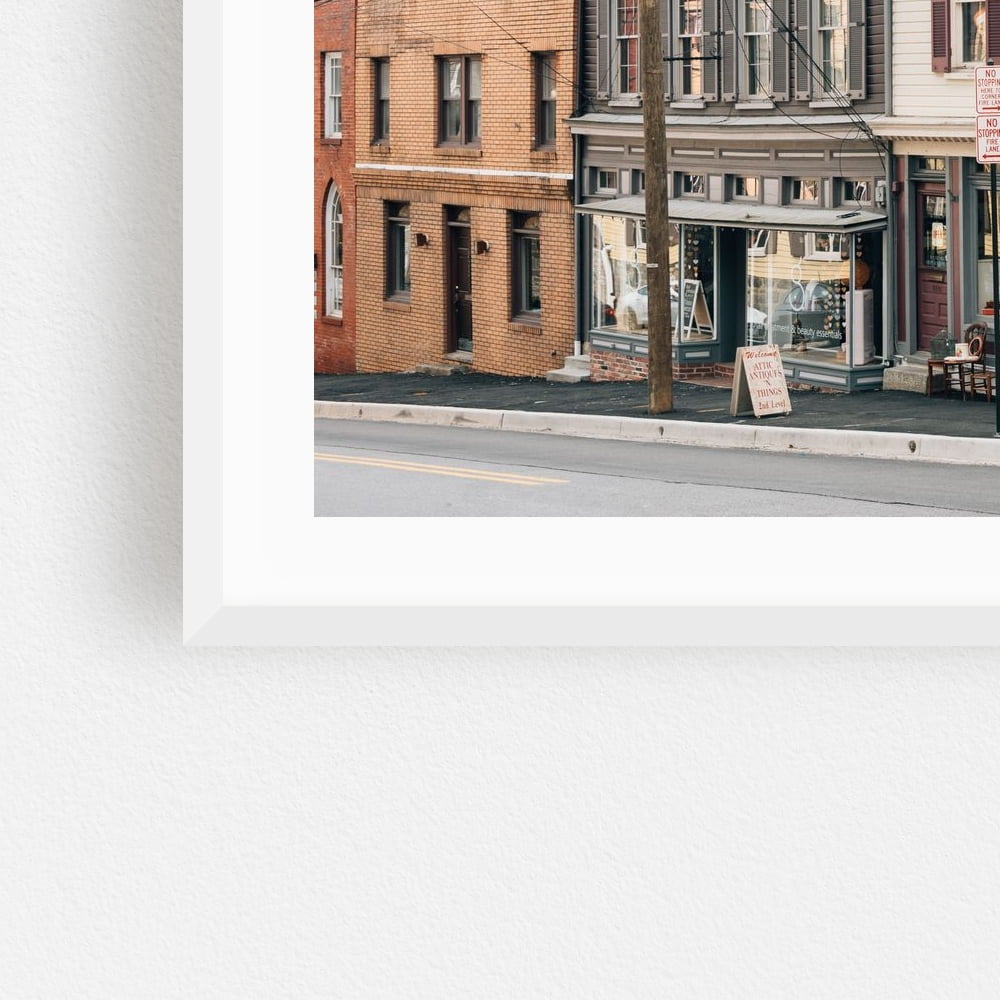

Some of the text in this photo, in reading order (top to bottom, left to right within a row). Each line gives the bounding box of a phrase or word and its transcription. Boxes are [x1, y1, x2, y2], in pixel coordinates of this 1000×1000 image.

[987, 119, 997, 127] NO
[797, 325, 815, 339] beauty
[745, 351, 777, 359] Welcome
[753, 361, 772, 371] ATTIC
[749, 369, 783, 380] ANTIQUES
[756, 387, 783, 398] THINGS
[771, 400, 785, 408] Level
